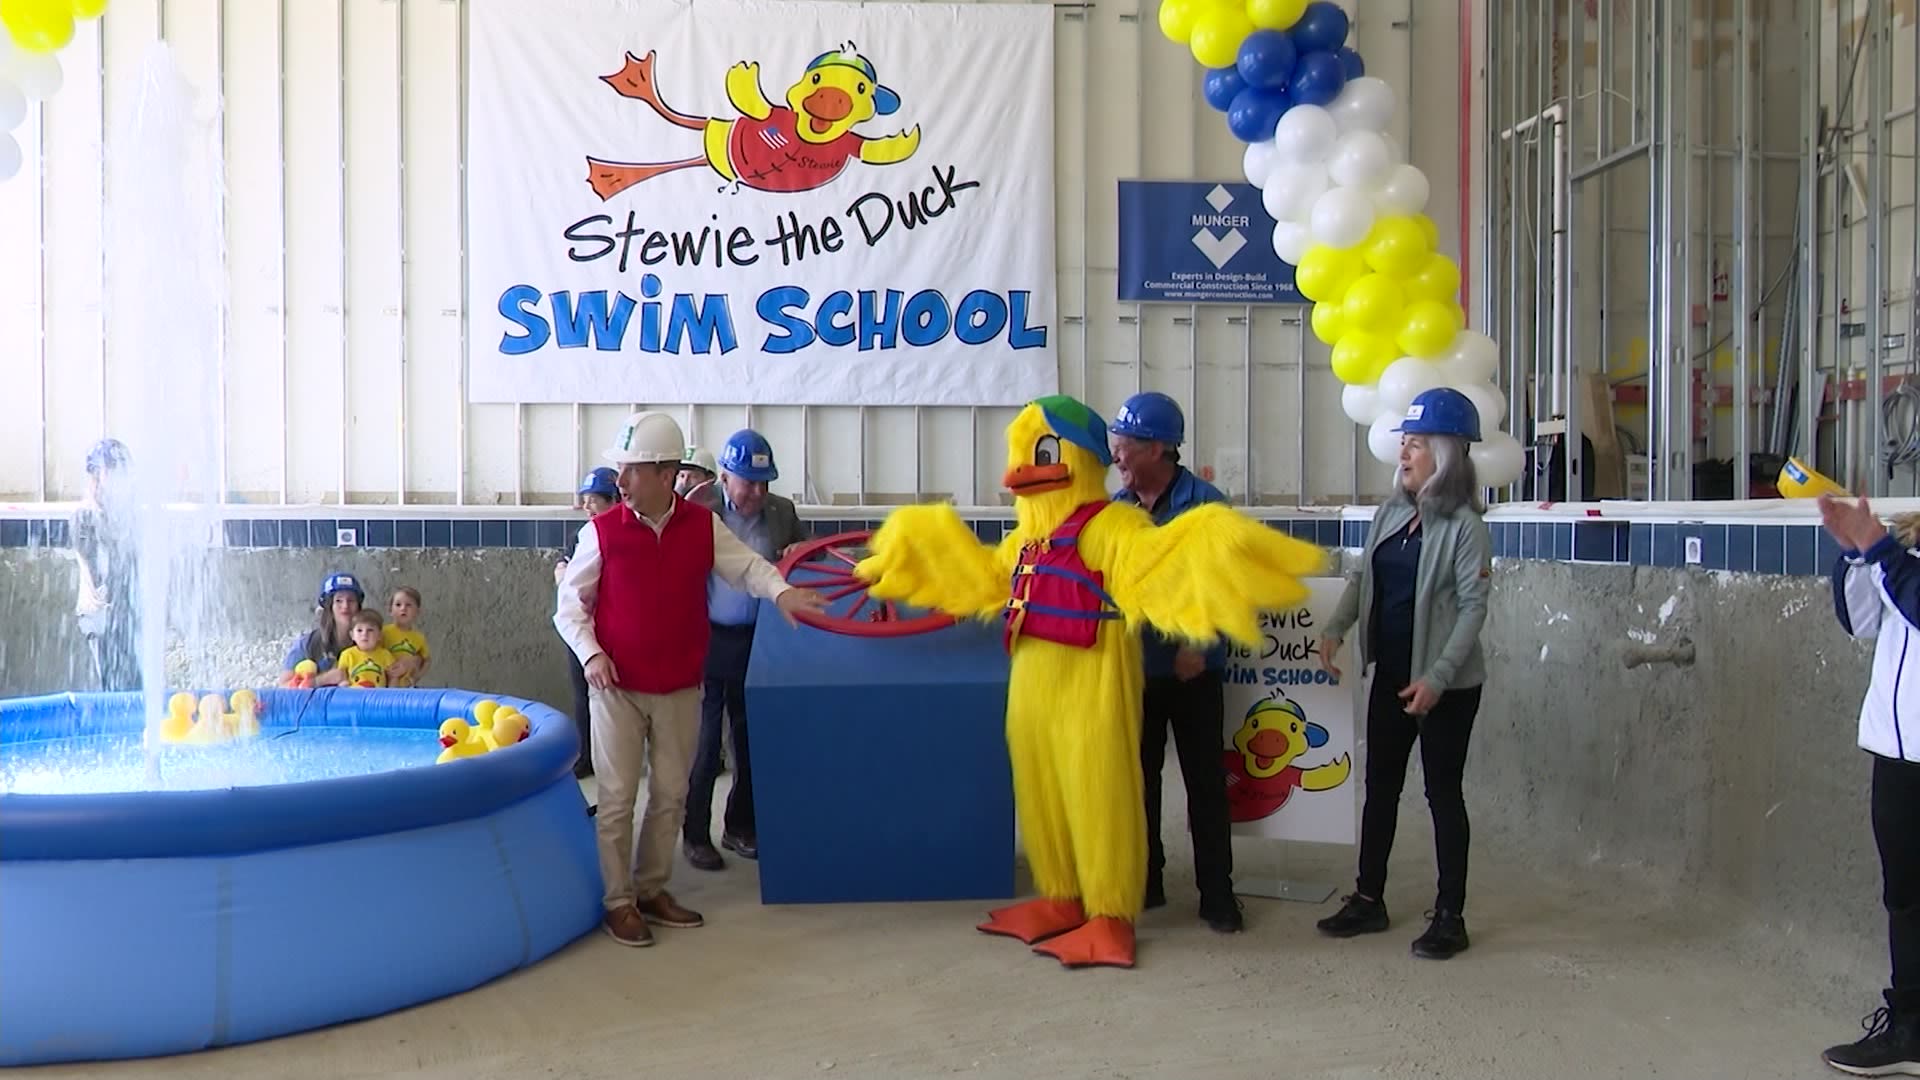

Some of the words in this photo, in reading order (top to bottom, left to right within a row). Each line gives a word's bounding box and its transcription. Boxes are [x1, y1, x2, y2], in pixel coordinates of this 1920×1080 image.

[798, 156, 842, 169] Stewie
[563, 210, 760, 272] Stewie
[765, 212, 844, 267] the
[846, 164, 980, 247] Duck
[1192, 214, 1250, 228] MUNGER
[1171, 272, 1203, 282] Experts
[1205, 272, 1213, 280] in
[1214, 272, 1267, 282] Design-Build
[1144, 280, 1194, 290] Commercial
[1195, 281, 1250, 291] Construction
[1251, 282, 1273, 291] Since
[1275, 283, 1294, 291] 1968
[1164, 291, 1274, 299] www.mungerconstruction.com
[755, 288, 1048, 354] SCHOOL
[1257, 607, 1313, 629] ewie
